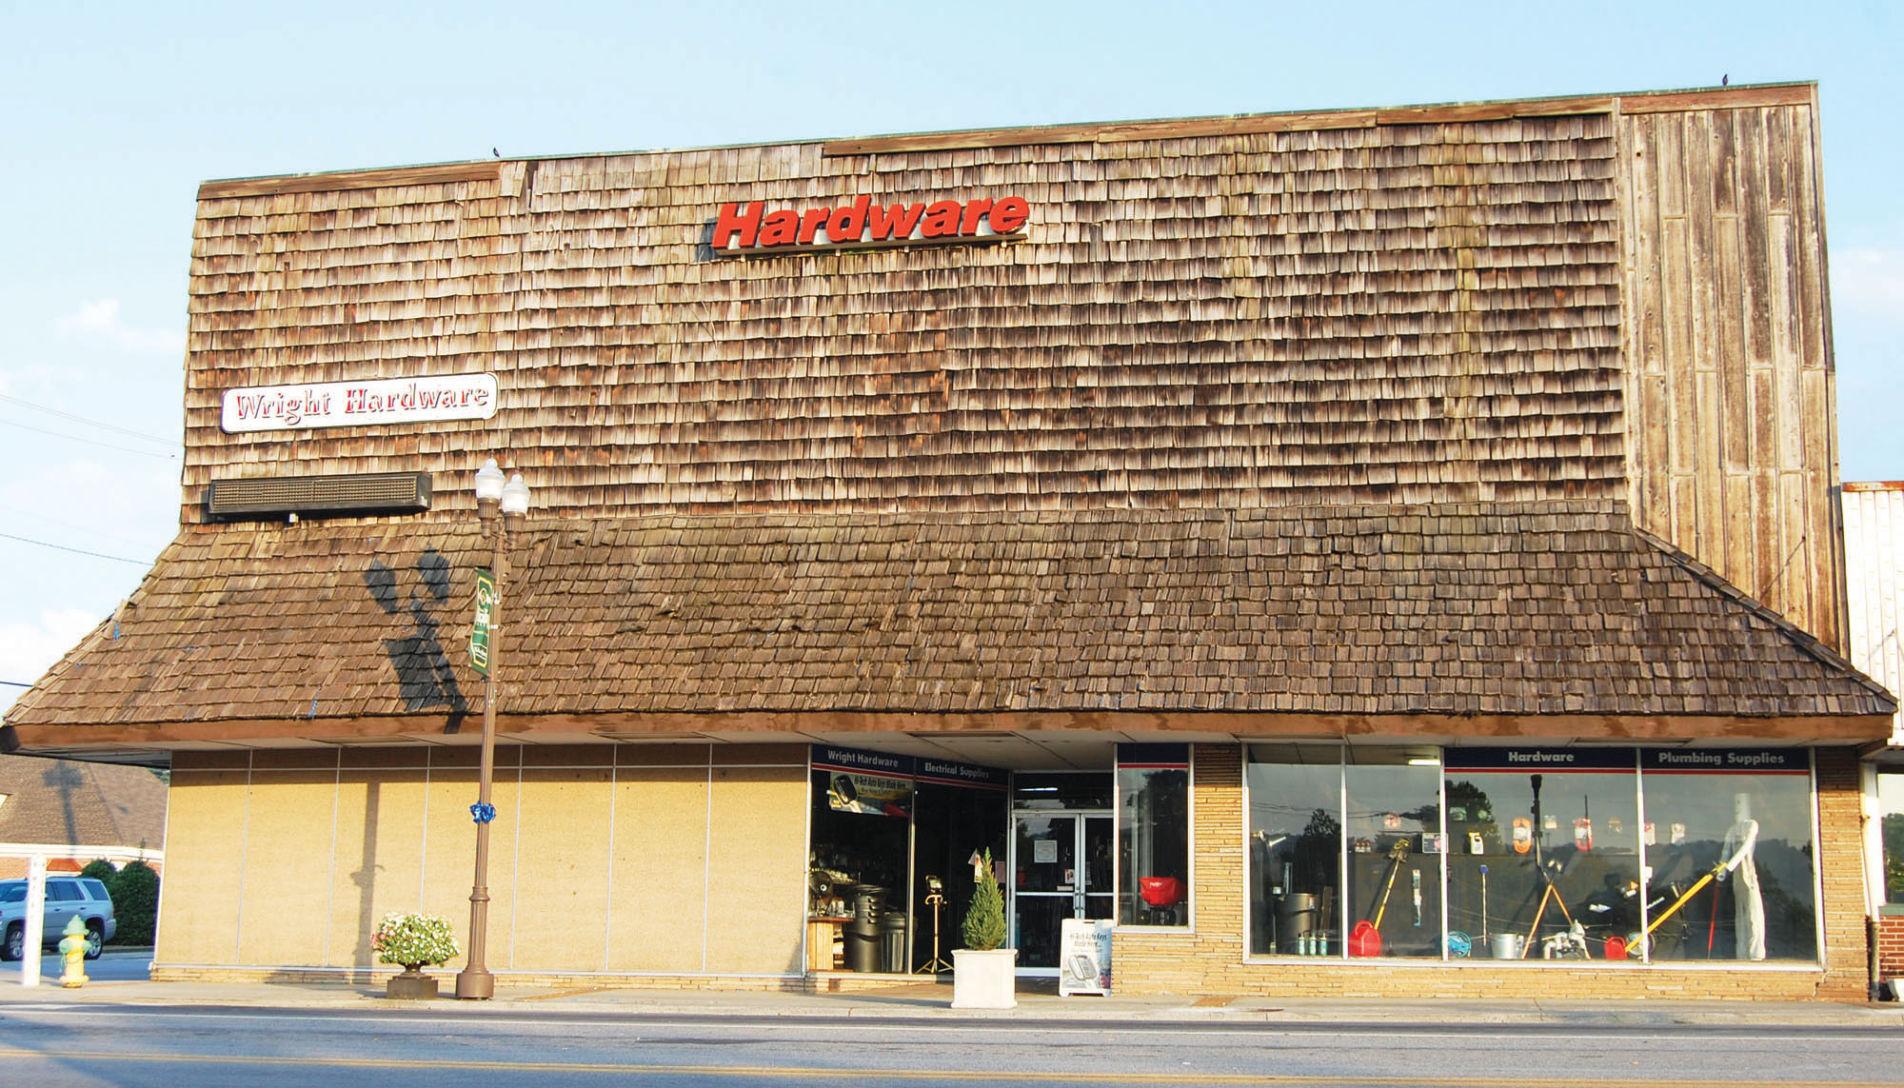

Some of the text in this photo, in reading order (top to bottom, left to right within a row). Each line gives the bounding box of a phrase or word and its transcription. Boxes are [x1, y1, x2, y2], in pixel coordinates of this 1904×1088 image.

[712, 195, 1030, 249] Hardware
[236, 383, 489, 425] Wright Hardware
[827, 749, 899, 768] Wright Hardware
[1508, 750, 1574, 762] Hardware
[1658, 751, 1785, 765] Plumbing Supplies
[924, 761, 989, 779] Electrical Supplies
